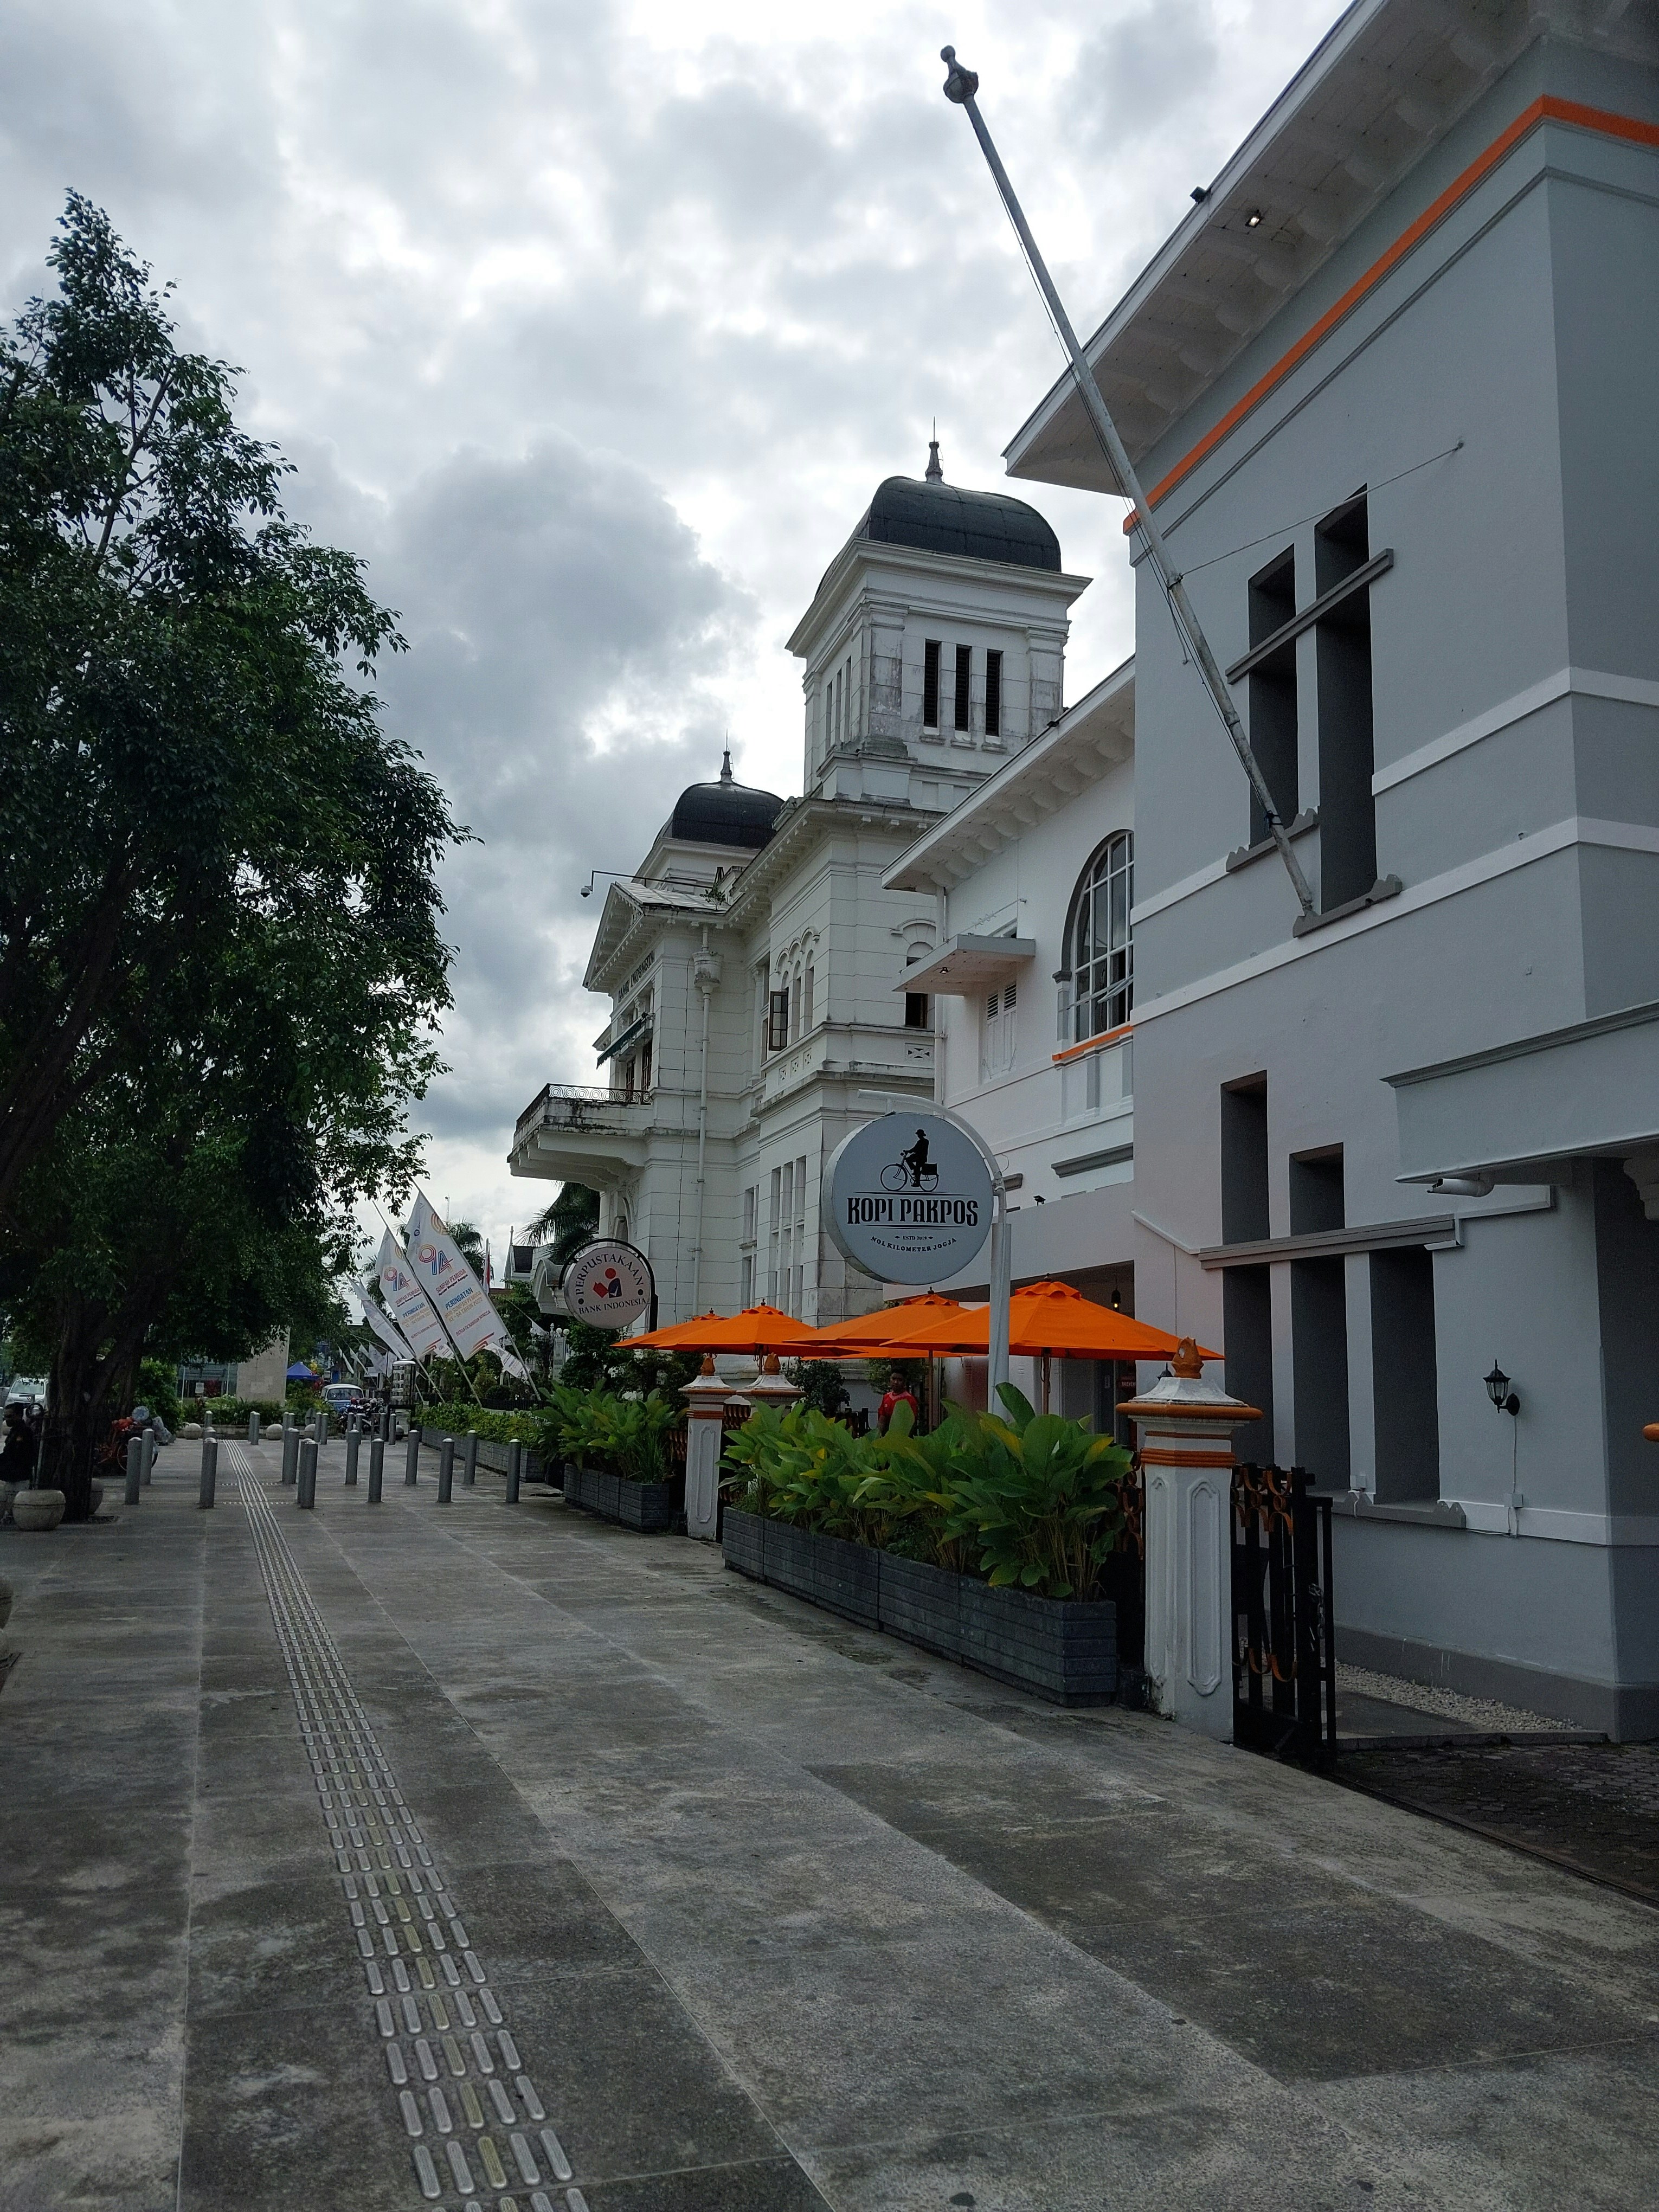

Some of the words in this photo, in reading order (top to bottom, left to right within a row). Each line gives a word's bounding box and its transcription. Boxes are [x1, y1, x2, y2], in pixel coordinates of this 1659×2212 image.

[847, 1197, 893, 1224] KOPI
[899, 1199, 979, 1226] PAKPOS
[871, 1236, 885, 1246] NOL
[886, 1243, 931, 1252] KILOMETER
[933, 1238, 956, 1250] JOGJA
[419, 1244, 453, 1275] 94
[384, 1267, 411, 1291] 94
[575, 1253, 644, 1295] PERPUSTAKAAN
[445, 1287, 473, 1310] PERINGATAN
[578, 1304, 601, 1314] BANK
[604, 1298, 646, 1310] INDONESIA
